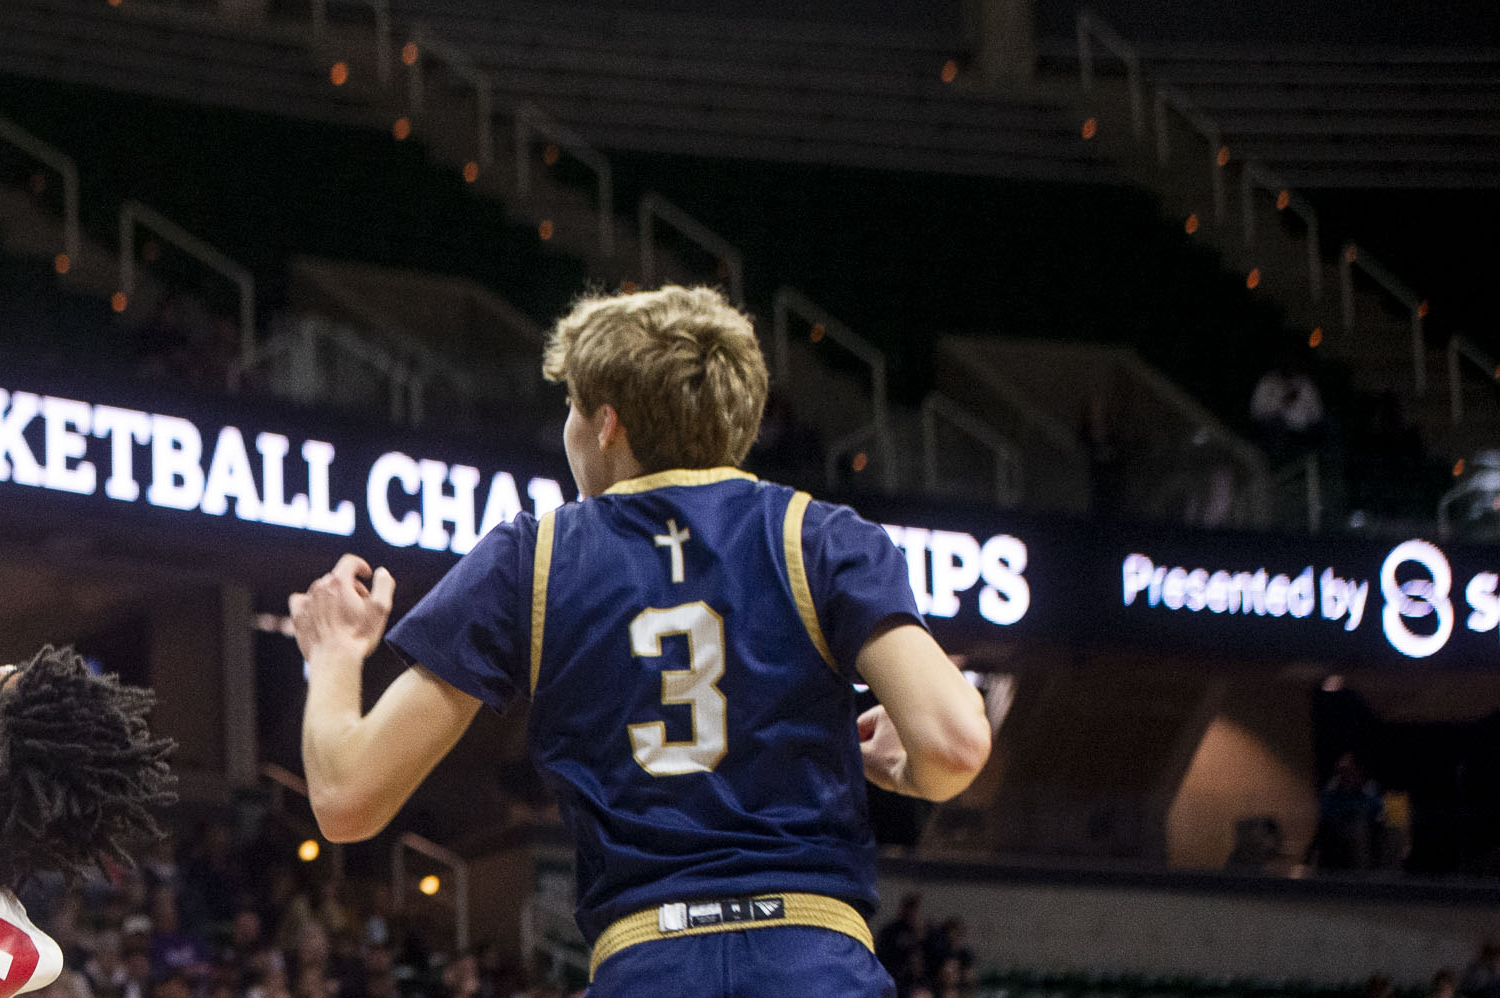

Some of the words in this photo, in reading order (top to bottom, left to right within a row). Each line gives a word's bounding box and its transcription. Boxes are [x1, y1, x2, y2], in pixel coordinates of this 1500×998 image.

[1123, 553, 1315, 619] Presented
[1320, 567, 1368, 631] by
[628, 600, 728, 777] 3
